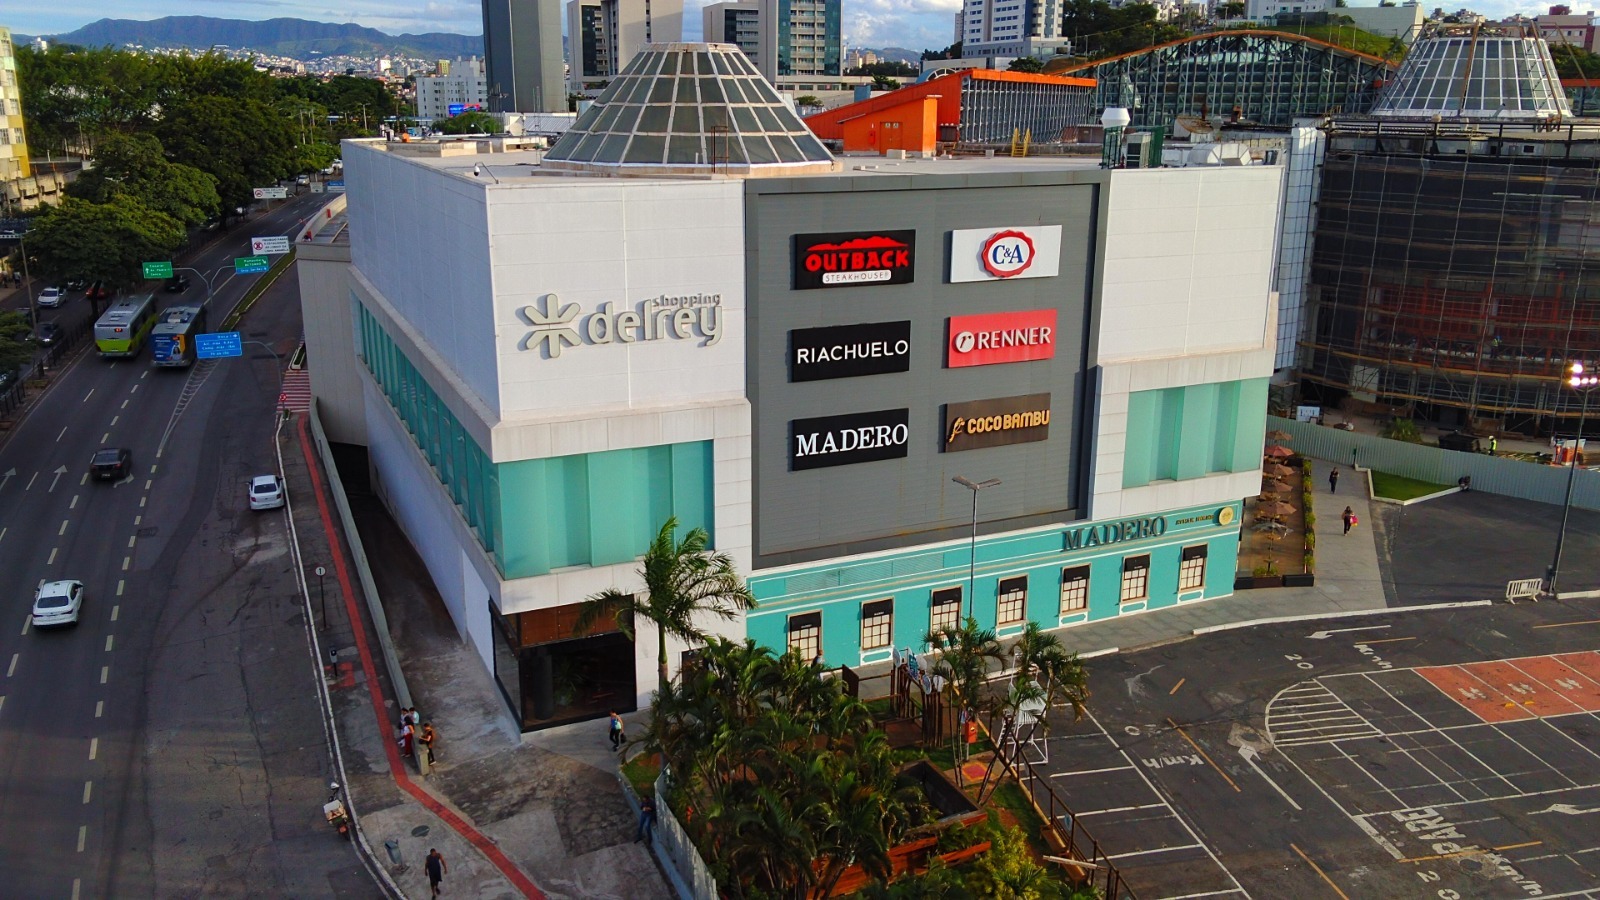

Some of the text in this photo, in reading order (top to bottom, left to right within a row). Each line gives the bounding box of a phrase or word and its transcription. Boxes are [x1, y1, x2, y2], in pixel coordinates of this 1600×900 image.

[805, 249, 909, 271] OUTBACK
[992, 244, 1024, 265] C&A
[652, 292, 722, 308] shopping
[587, 300, 723, 347] delrey
[978, 326, 1052, 350] RENNER
[797, 340, 909, 364] RIACHUELO
[796, 423, 909, 456] MADERO
[1062, 516, 1168, 550] MADERO
[1142, 754, 1204, 769] Km/h
[1391, 807, 1479, 855] PARE
